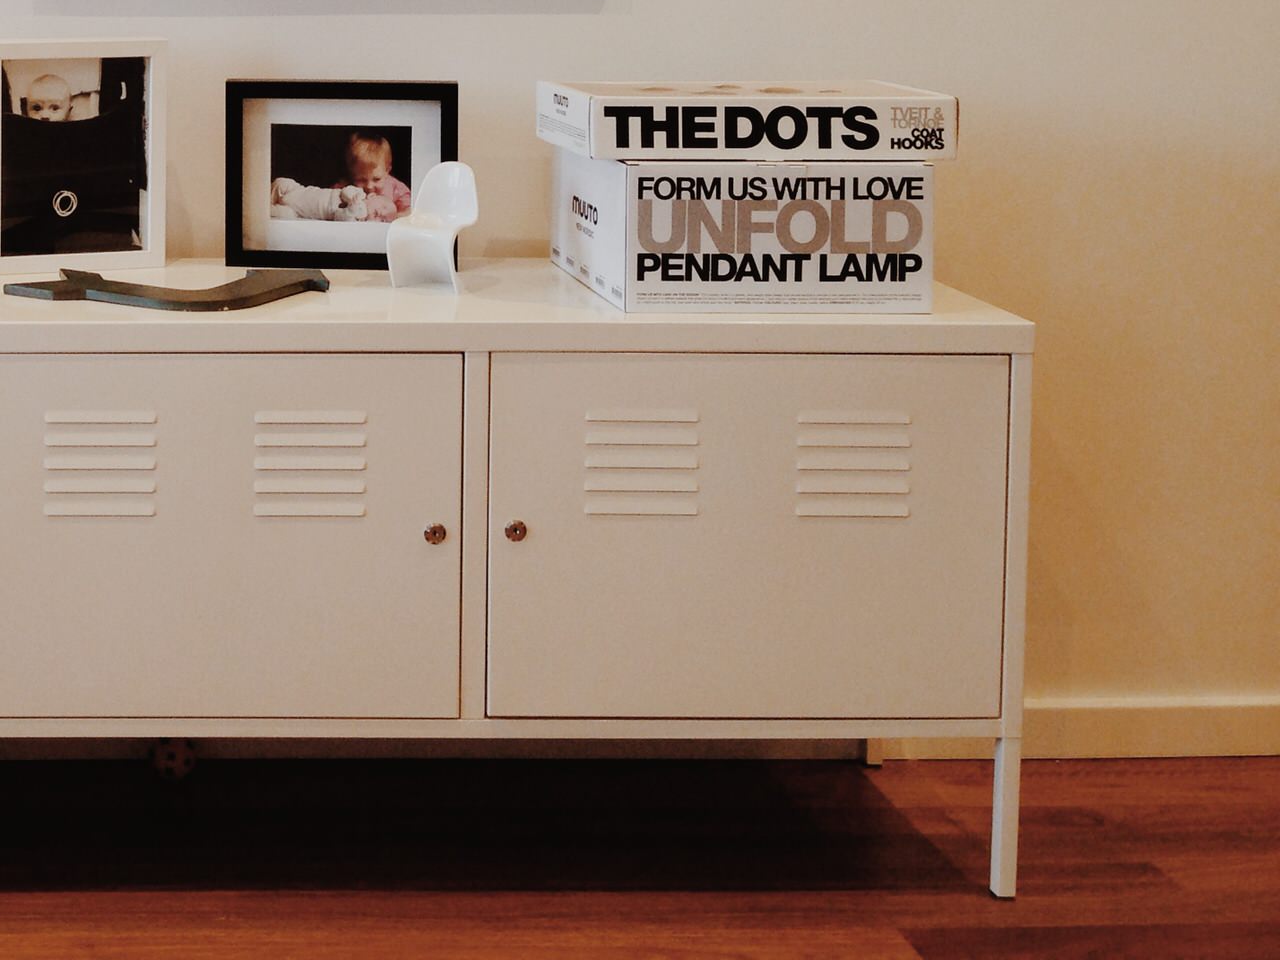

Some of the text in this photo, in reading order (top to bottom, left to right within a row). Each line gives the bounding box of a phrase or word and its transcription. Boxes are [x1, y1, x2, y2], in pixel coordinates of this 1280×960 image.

[604, 106, 719, 149] THE
[724, 105, 880, 151] DOTS
[911, 128, 945, 140] COAT
[890, 137, 945, 150] HOOKS
[637, 176, 925, 201] FORM US WITH LOVE
[637, 199, 924, 255] UNFOLD
[636, 253, 924, 282] PENDANT LAMP
